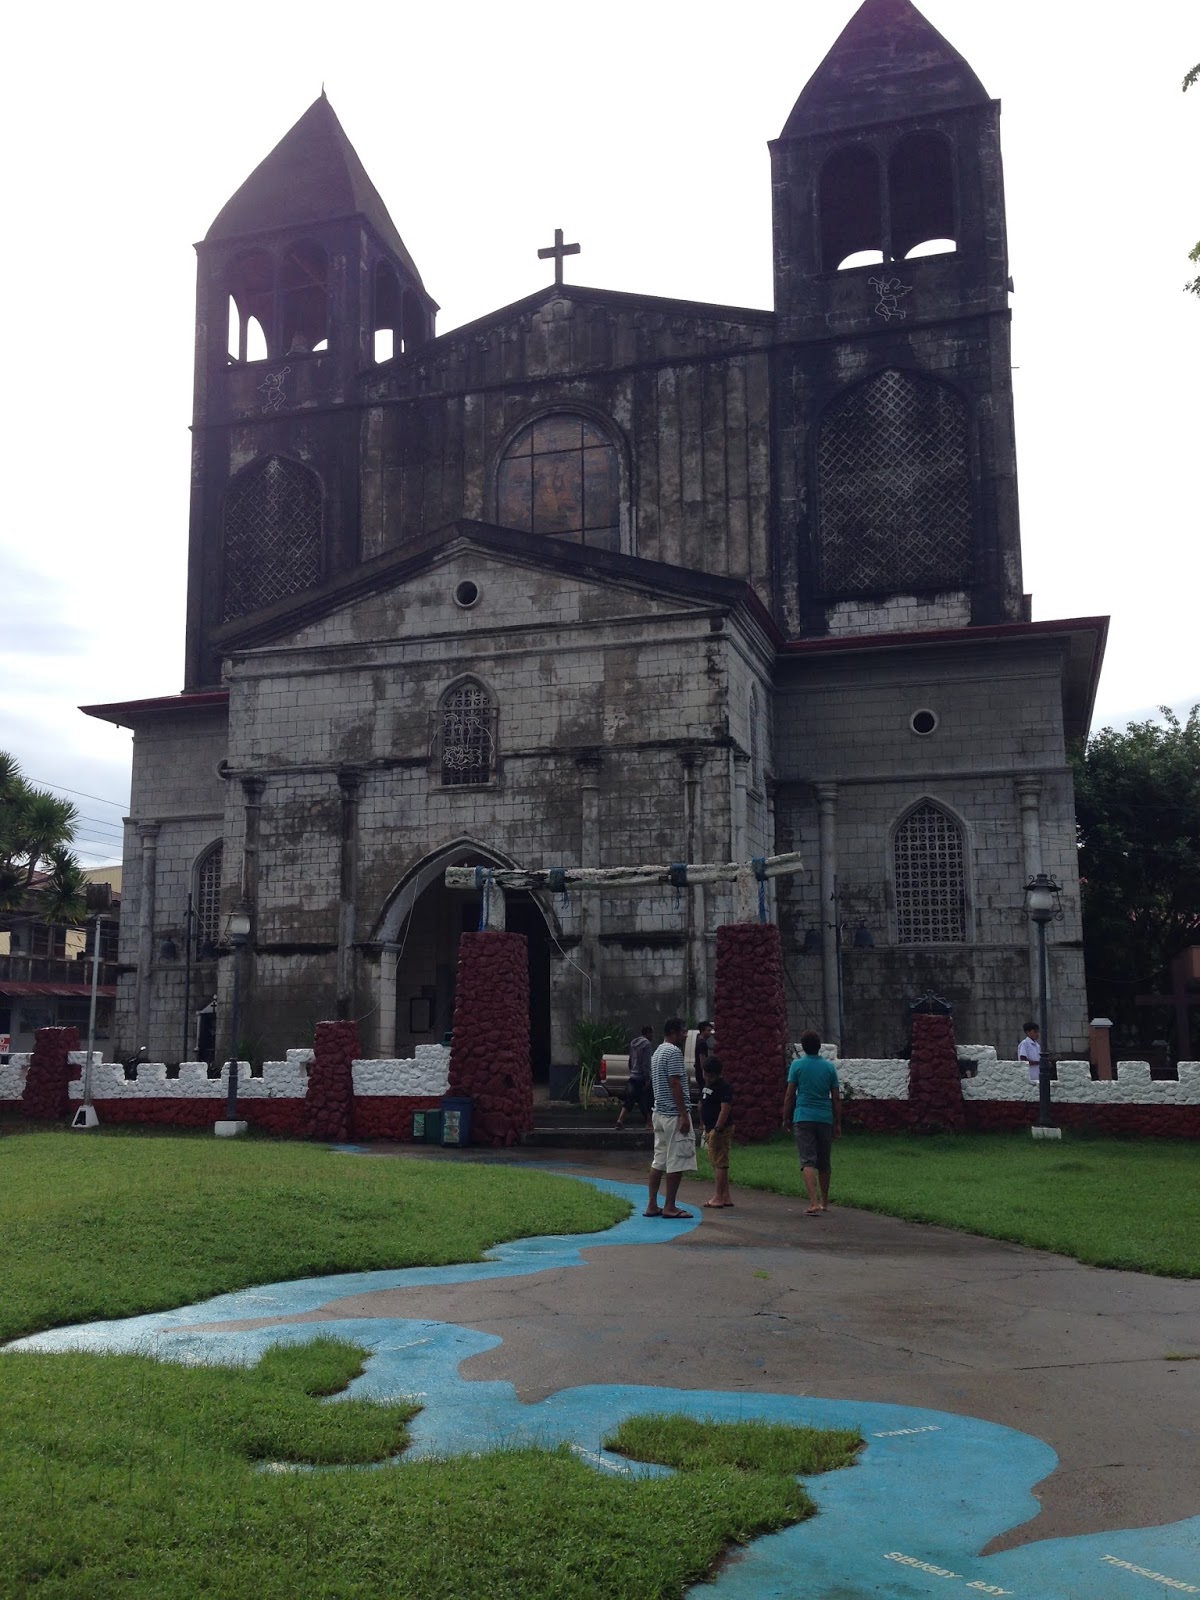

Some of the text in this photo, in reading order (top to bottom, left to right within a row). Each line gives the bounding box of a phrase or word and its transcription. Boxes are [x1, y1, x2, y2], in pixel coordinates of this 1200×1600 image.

[883, 1551, 1014, 1595] SIBUGAY BAY
[1099, 1554, 1200, 1592] TUNGAWAN
